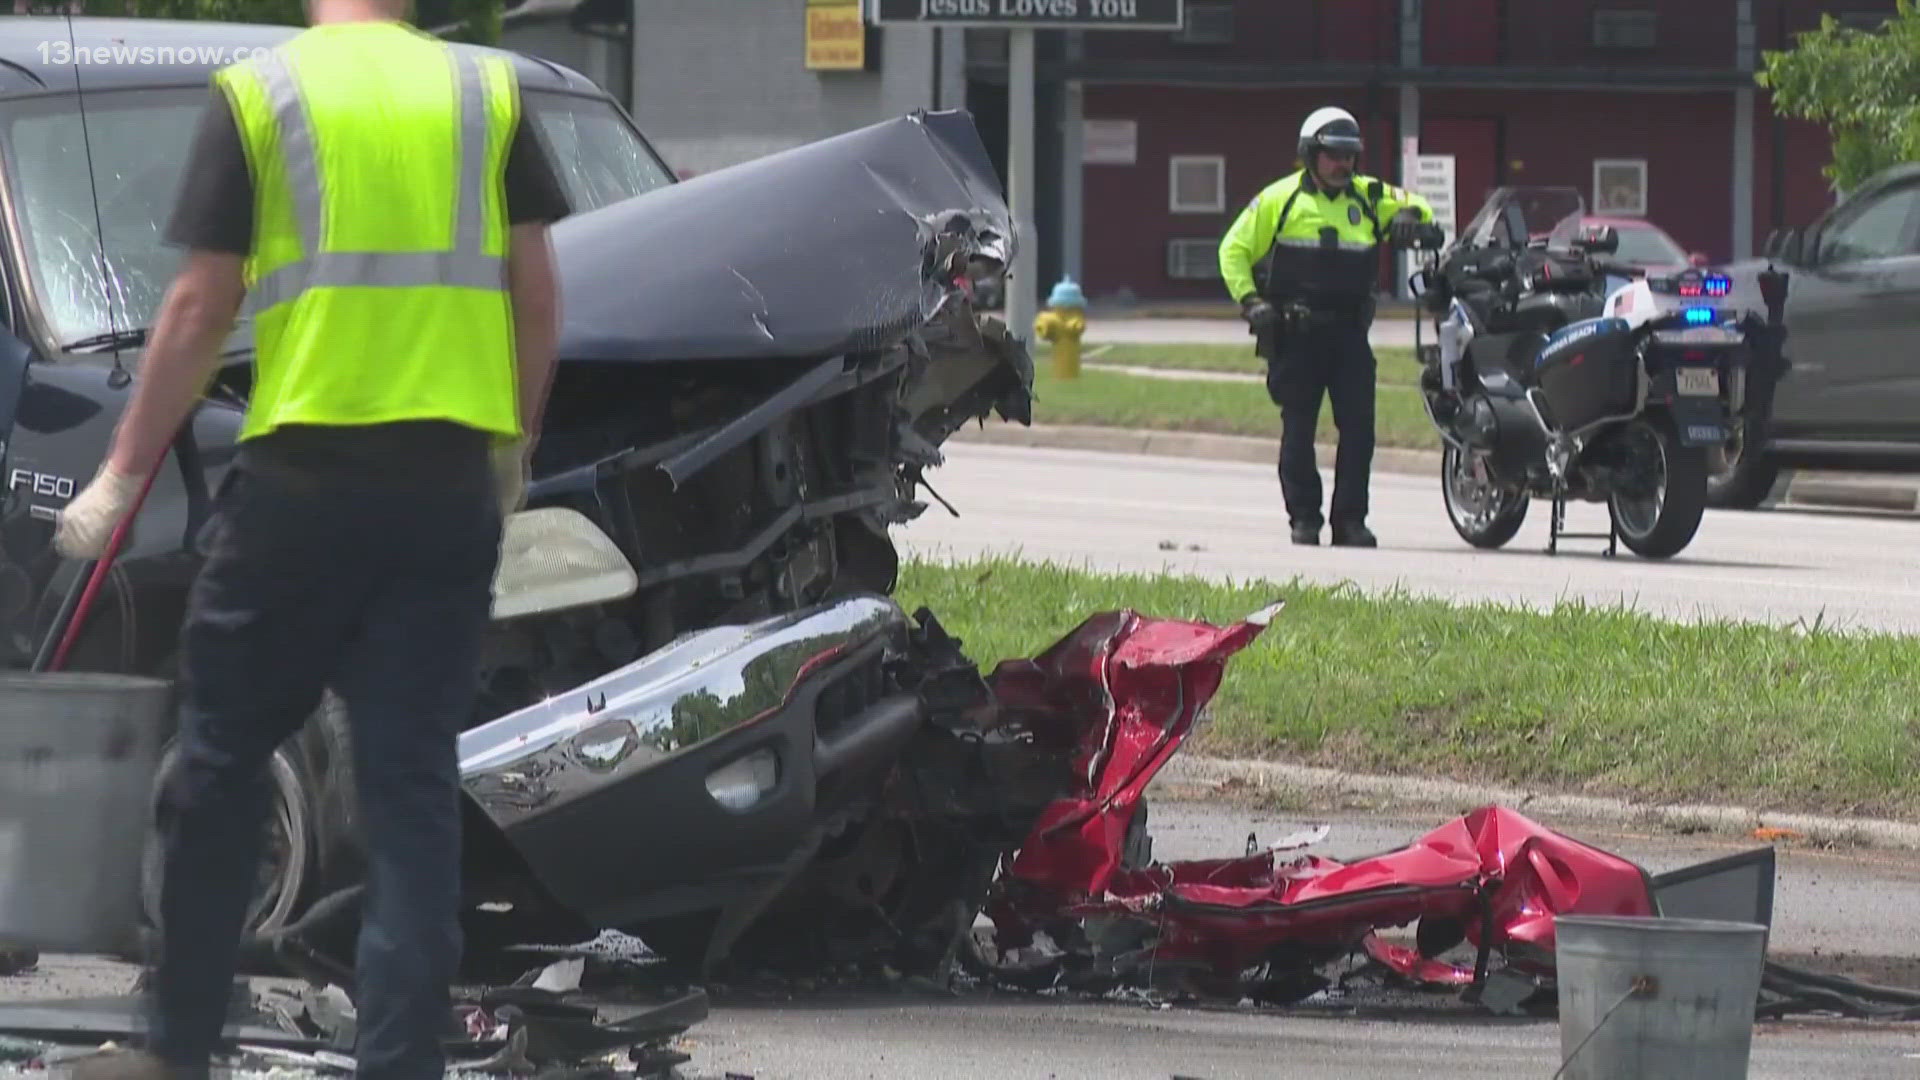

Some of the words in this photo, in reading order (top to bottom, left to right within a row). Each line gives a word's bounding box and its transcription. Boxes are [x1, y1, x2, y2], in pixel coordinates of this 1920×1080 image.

[918, 0, 990, 20] Jesus
[1000, 0, 1077, 17] Loves
[1089, 0, 1137, 17] You
